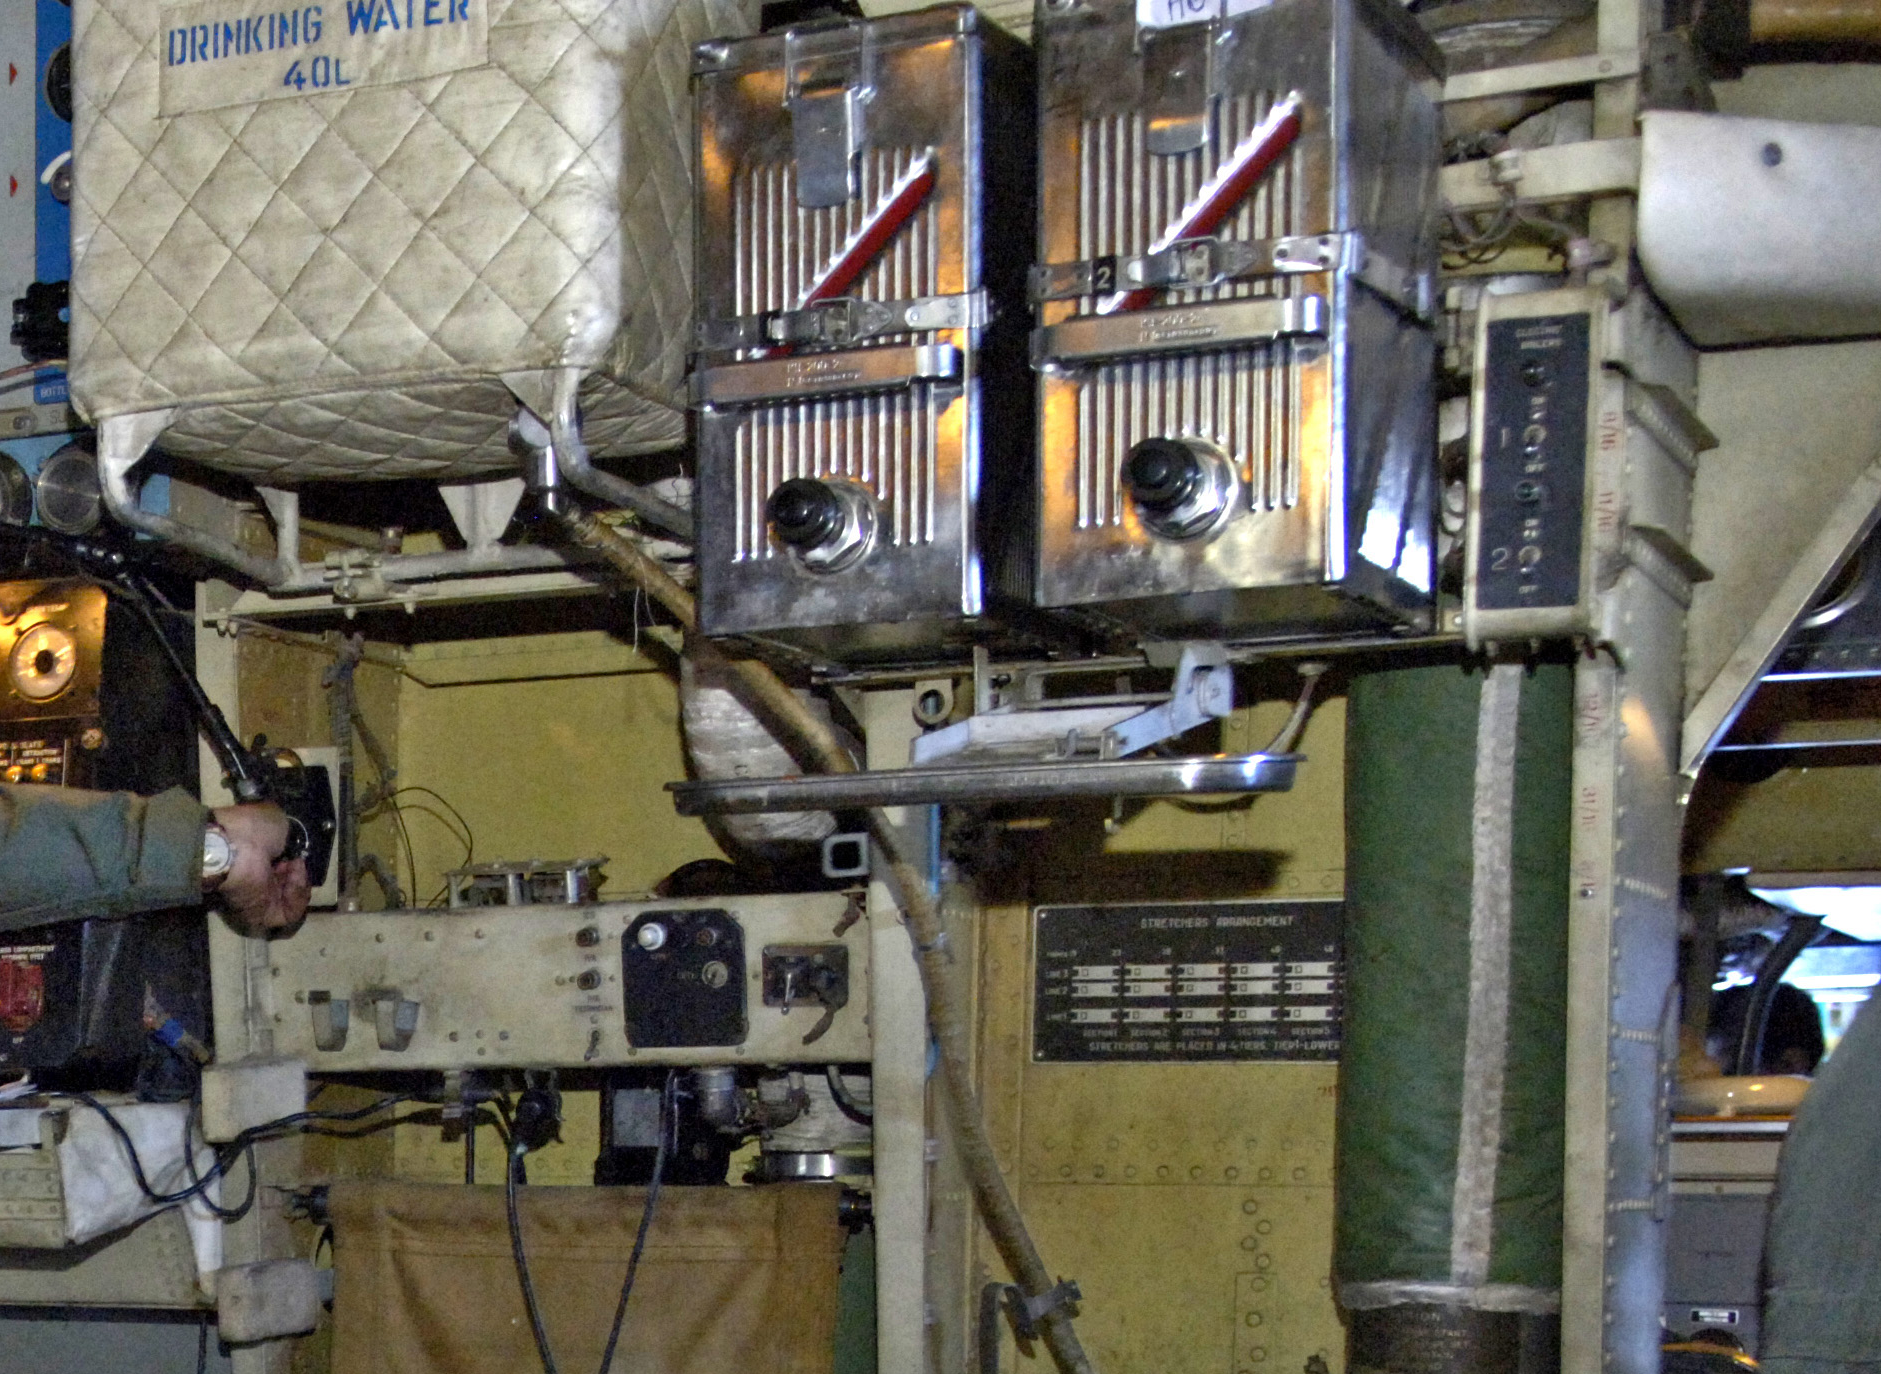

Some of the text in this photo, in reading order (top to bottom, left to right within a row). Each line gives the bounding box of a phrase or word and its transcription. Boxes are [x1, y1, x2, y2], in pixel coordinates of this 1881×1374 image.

[169, 0, 469, 66] DRINKING WATER
[283, 56, 351, 91] 40L
[1097, 265, 1111, 290] 2
[40, 386, 67, 399] BOTTL
[1491, 547, 1510, 571] 2
[1140, 915, 1294, 929] STRETCHERS ARRANGEMENT
[1089, 1041, 1149, 1051] STRETCHERS
